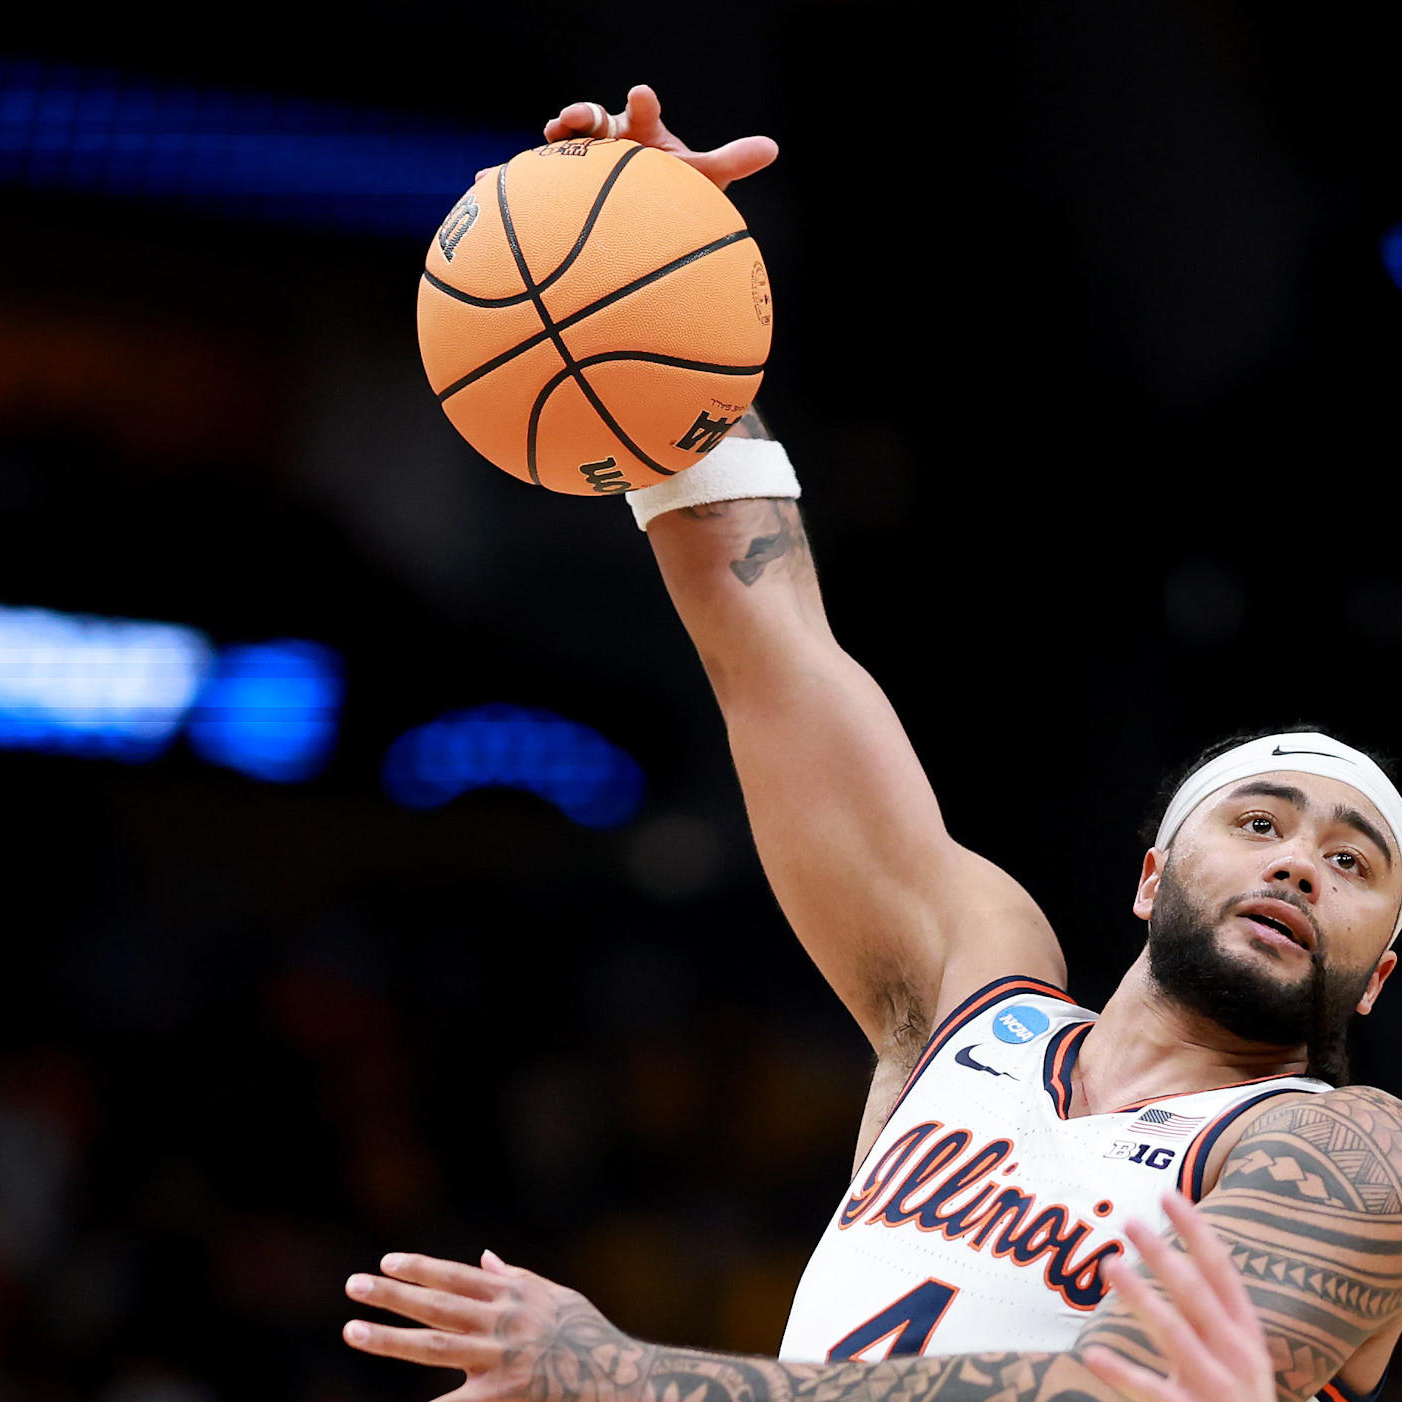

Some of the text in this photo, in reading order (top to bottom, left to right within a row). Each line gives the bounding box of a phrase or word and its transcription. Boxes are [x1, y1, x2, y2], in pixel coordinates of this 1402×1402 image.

[999, 1013, 1035, 1041] NCAA
[838, 1120, 1125, 1311] Illinois
[824, 1276, 960, 1365] 4
